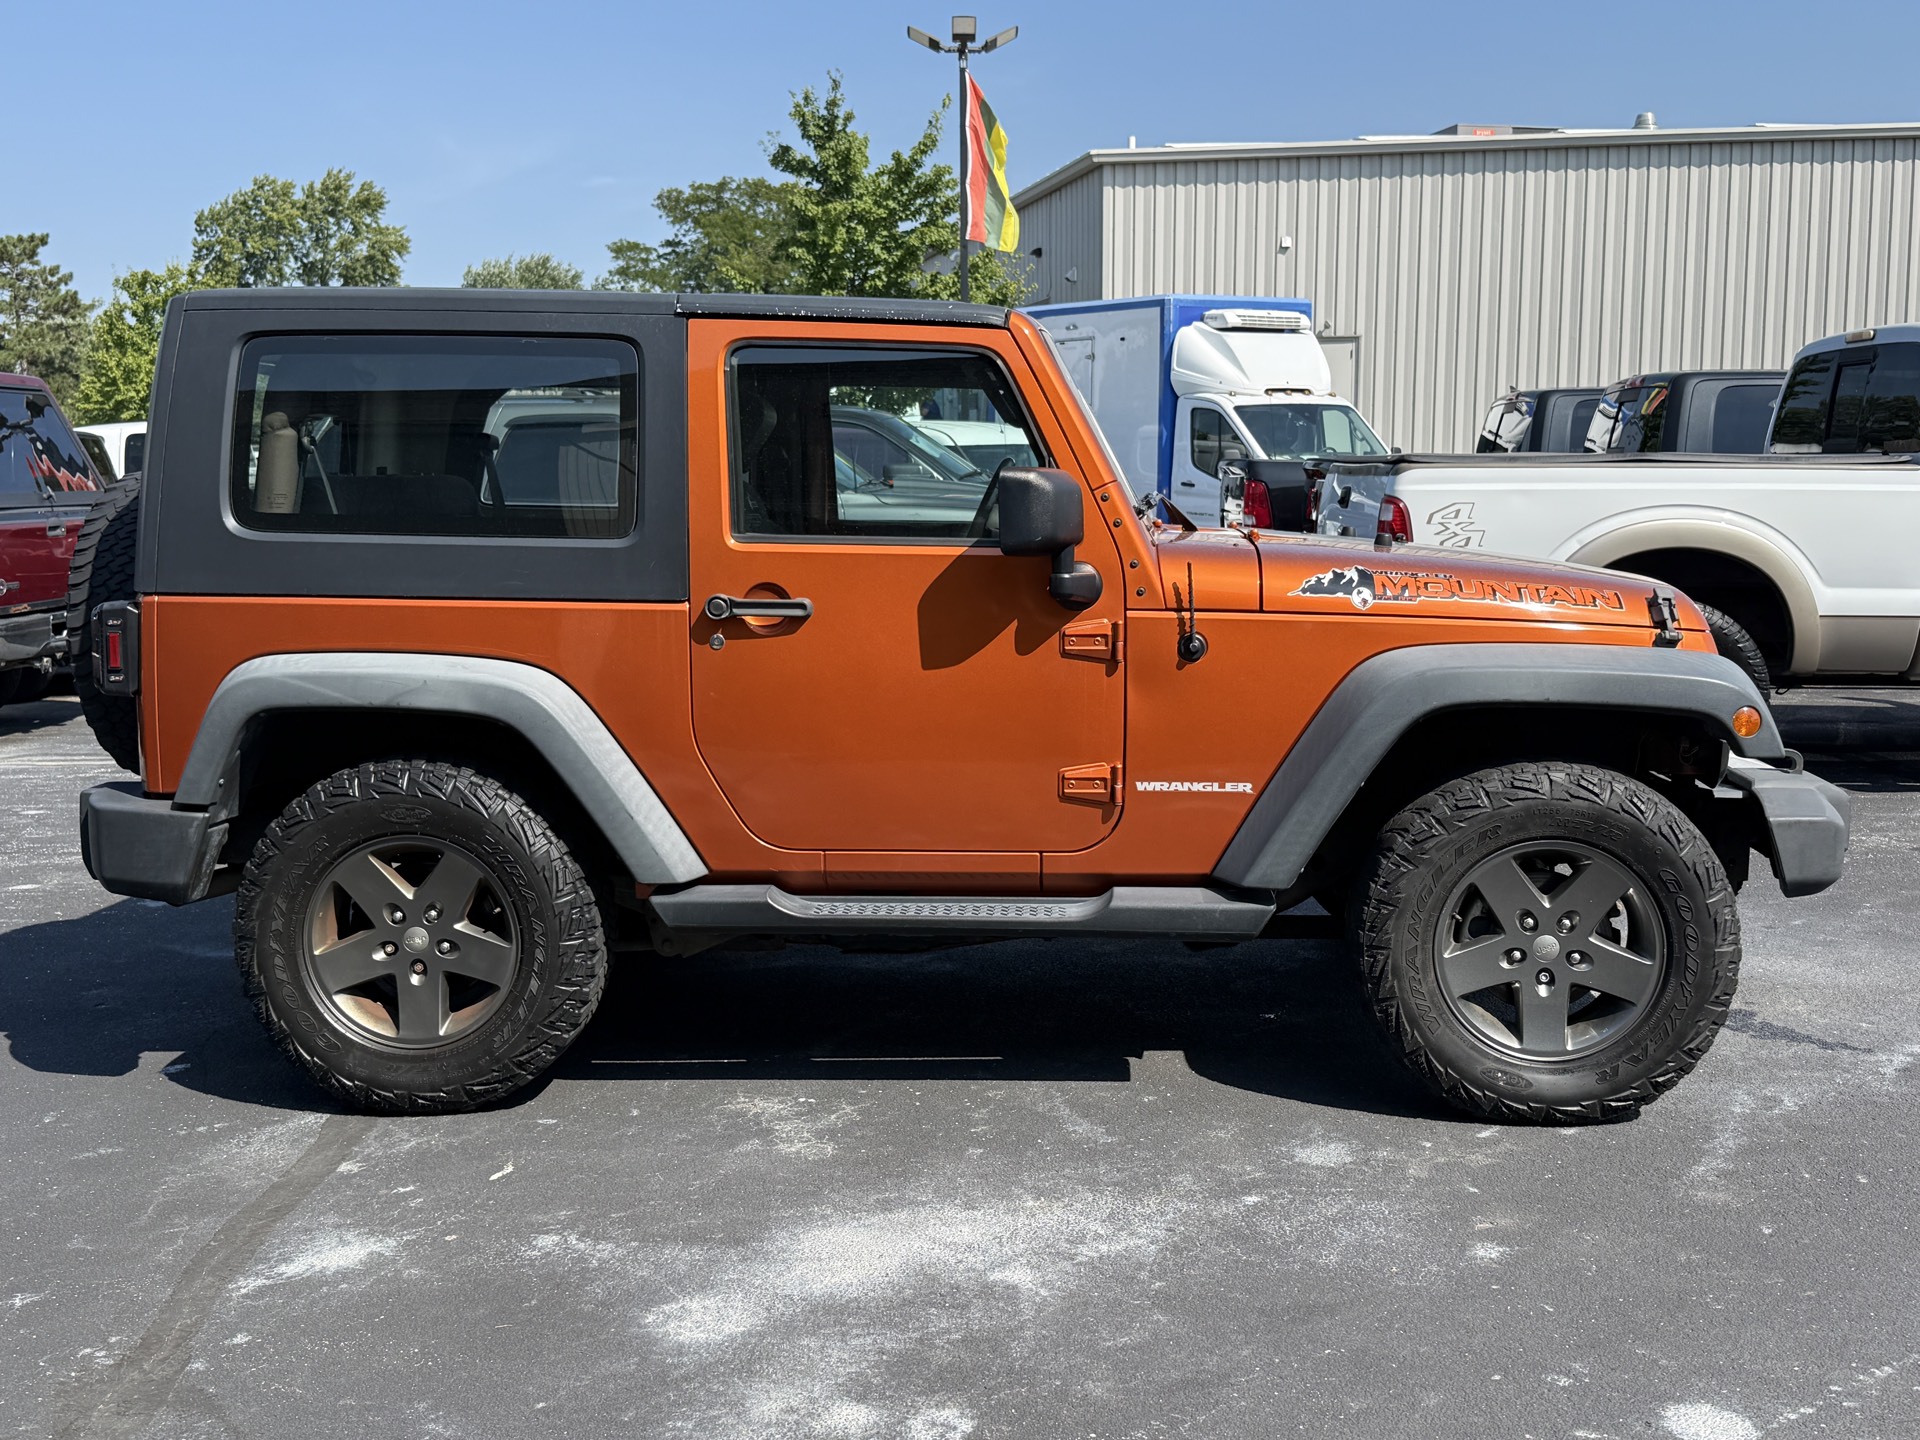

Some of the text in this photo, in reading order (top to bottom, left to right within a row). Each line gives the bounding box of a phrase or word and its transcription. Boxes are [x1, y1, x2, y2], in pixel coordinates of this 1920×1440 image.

[1373, 575, 1626, 611] MOUNTAIN
[1135, 781, 1256, 795] WRANGLER
[270, 834, 341, 1054] GOODYEAR
[1402, 822, 1504, 1035] WRANGLER
[1535, 942, 1557, 956] Jeep
[1595, 867, 1700, 1086] GOODYEAR
